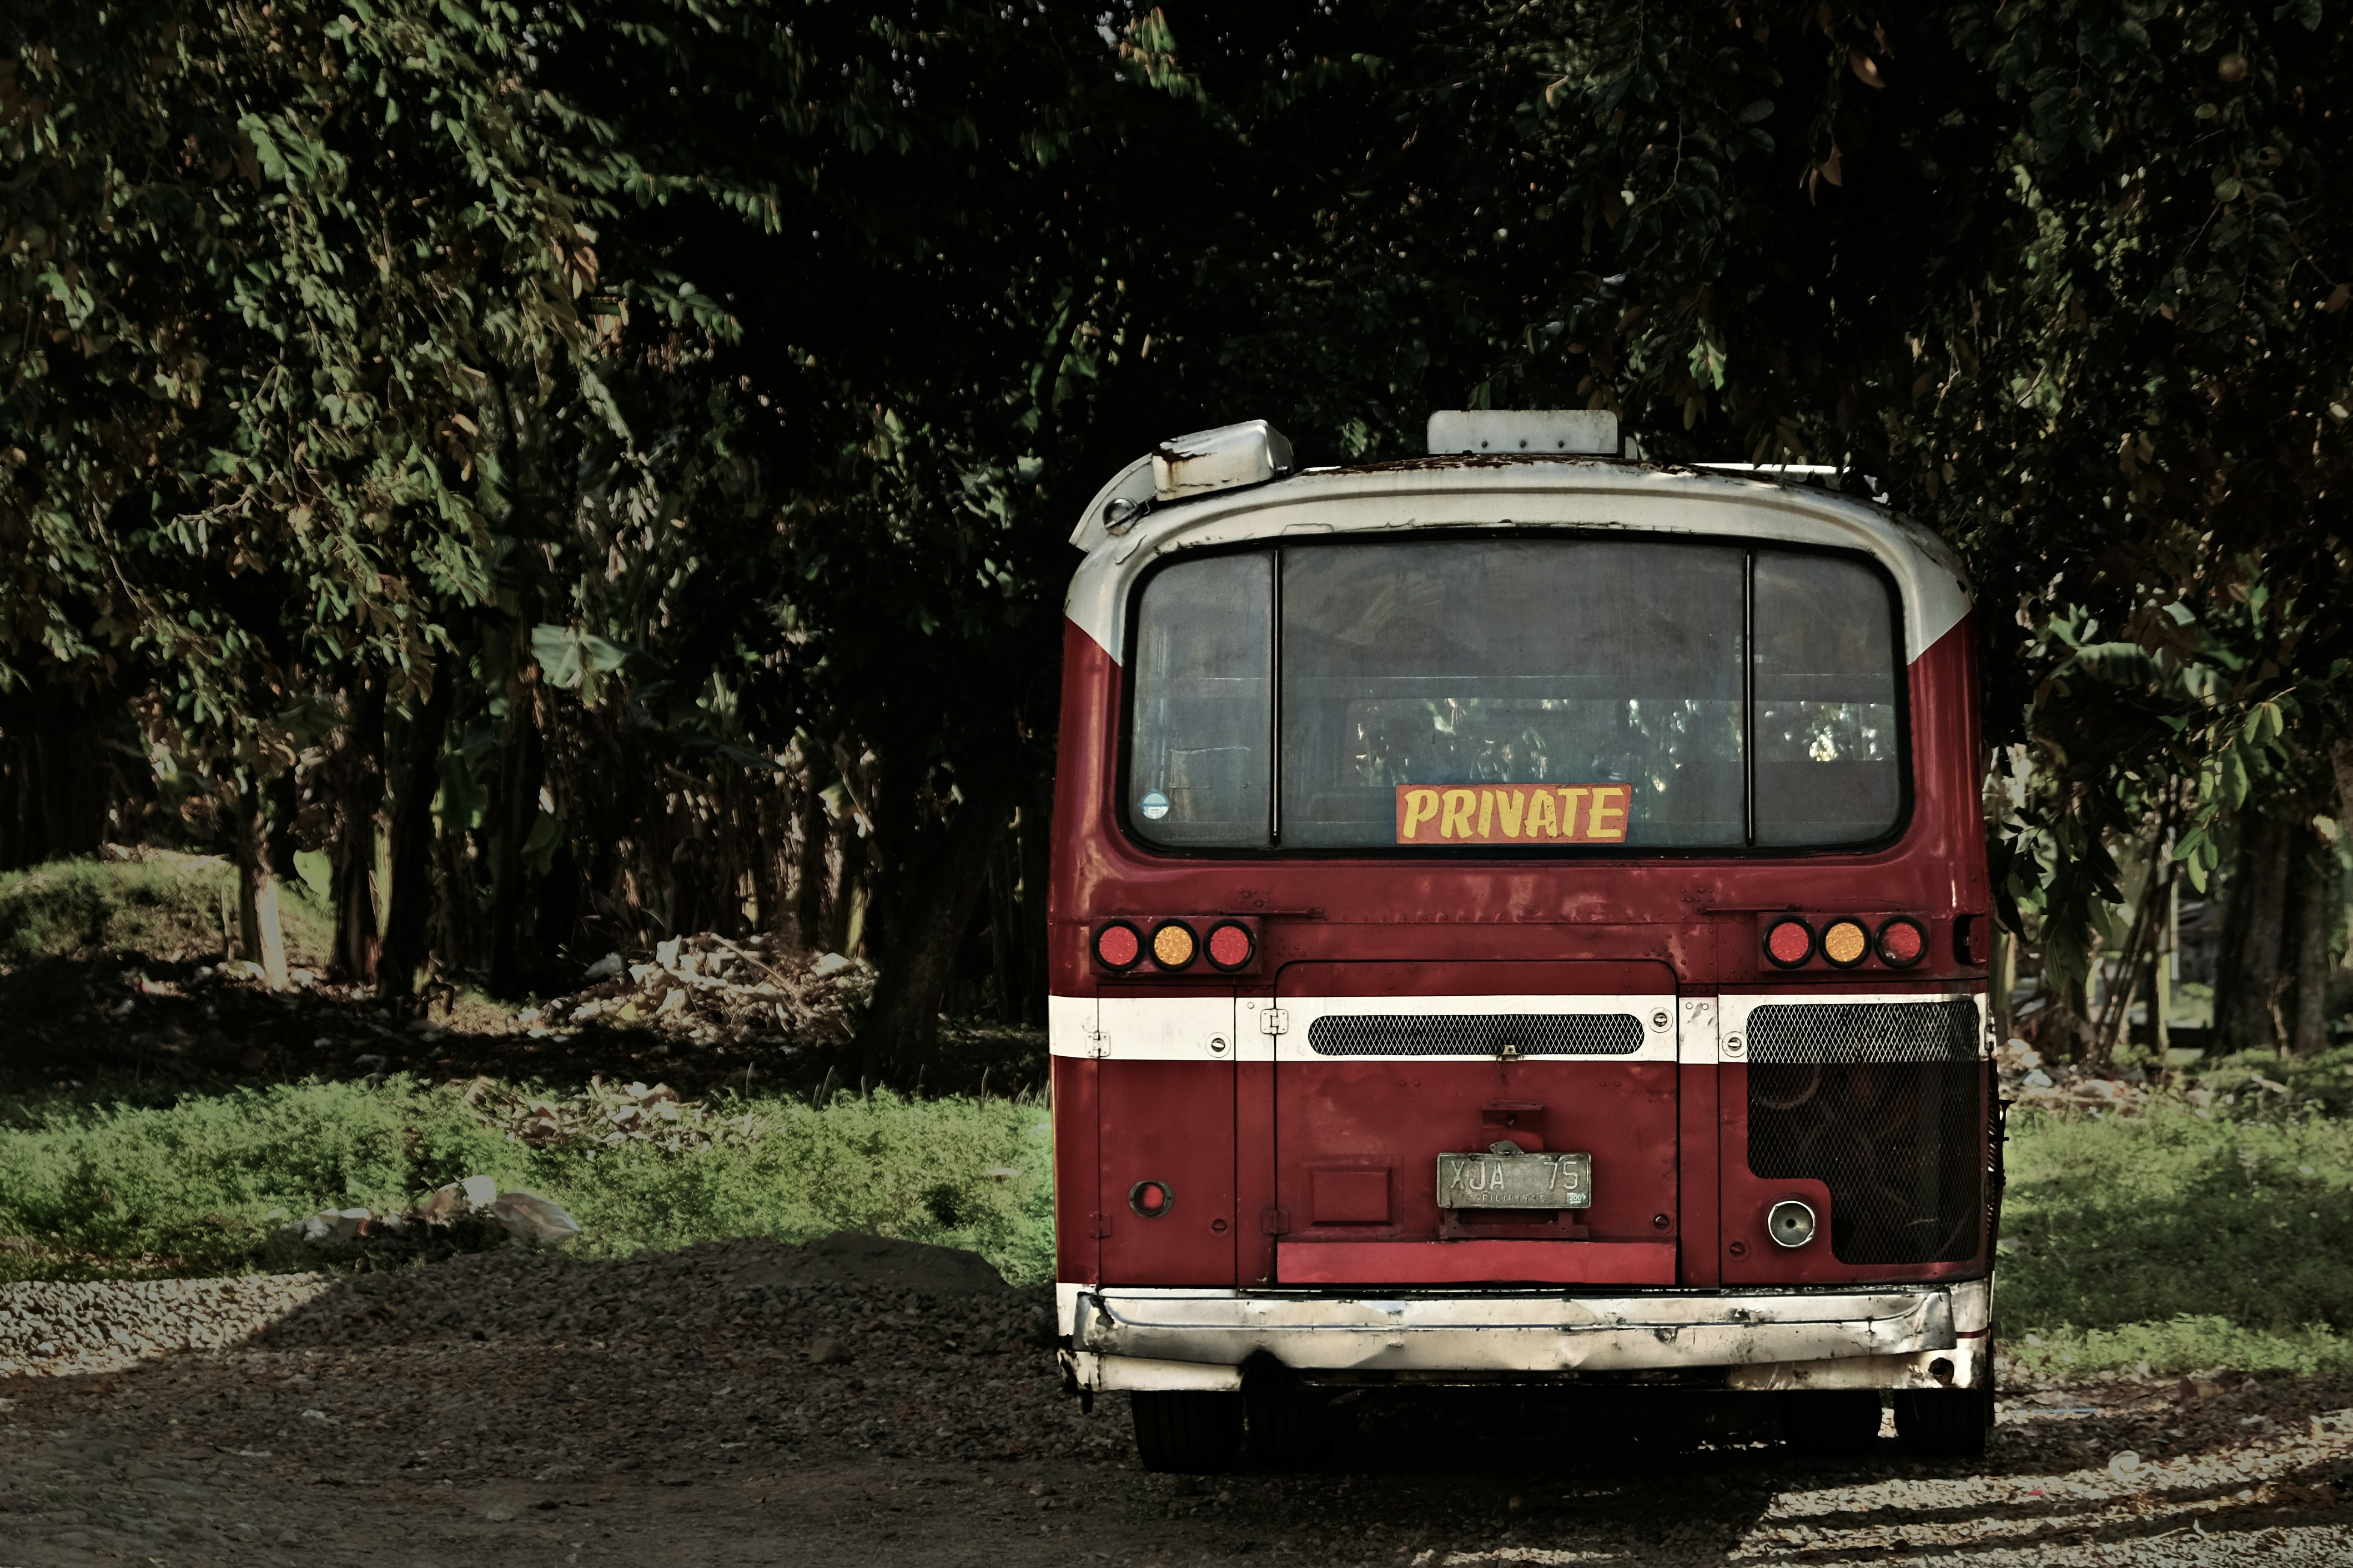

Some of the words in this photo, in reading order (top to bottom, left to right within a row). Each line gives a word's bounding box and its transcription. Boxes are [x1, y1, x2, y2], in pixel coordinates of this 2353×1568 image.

[1403, 788, 1624, 838] PRIVATE
[1450, 1160, 1504, 1190] XJA
[1544, 1161, 1577, 1190] 75
